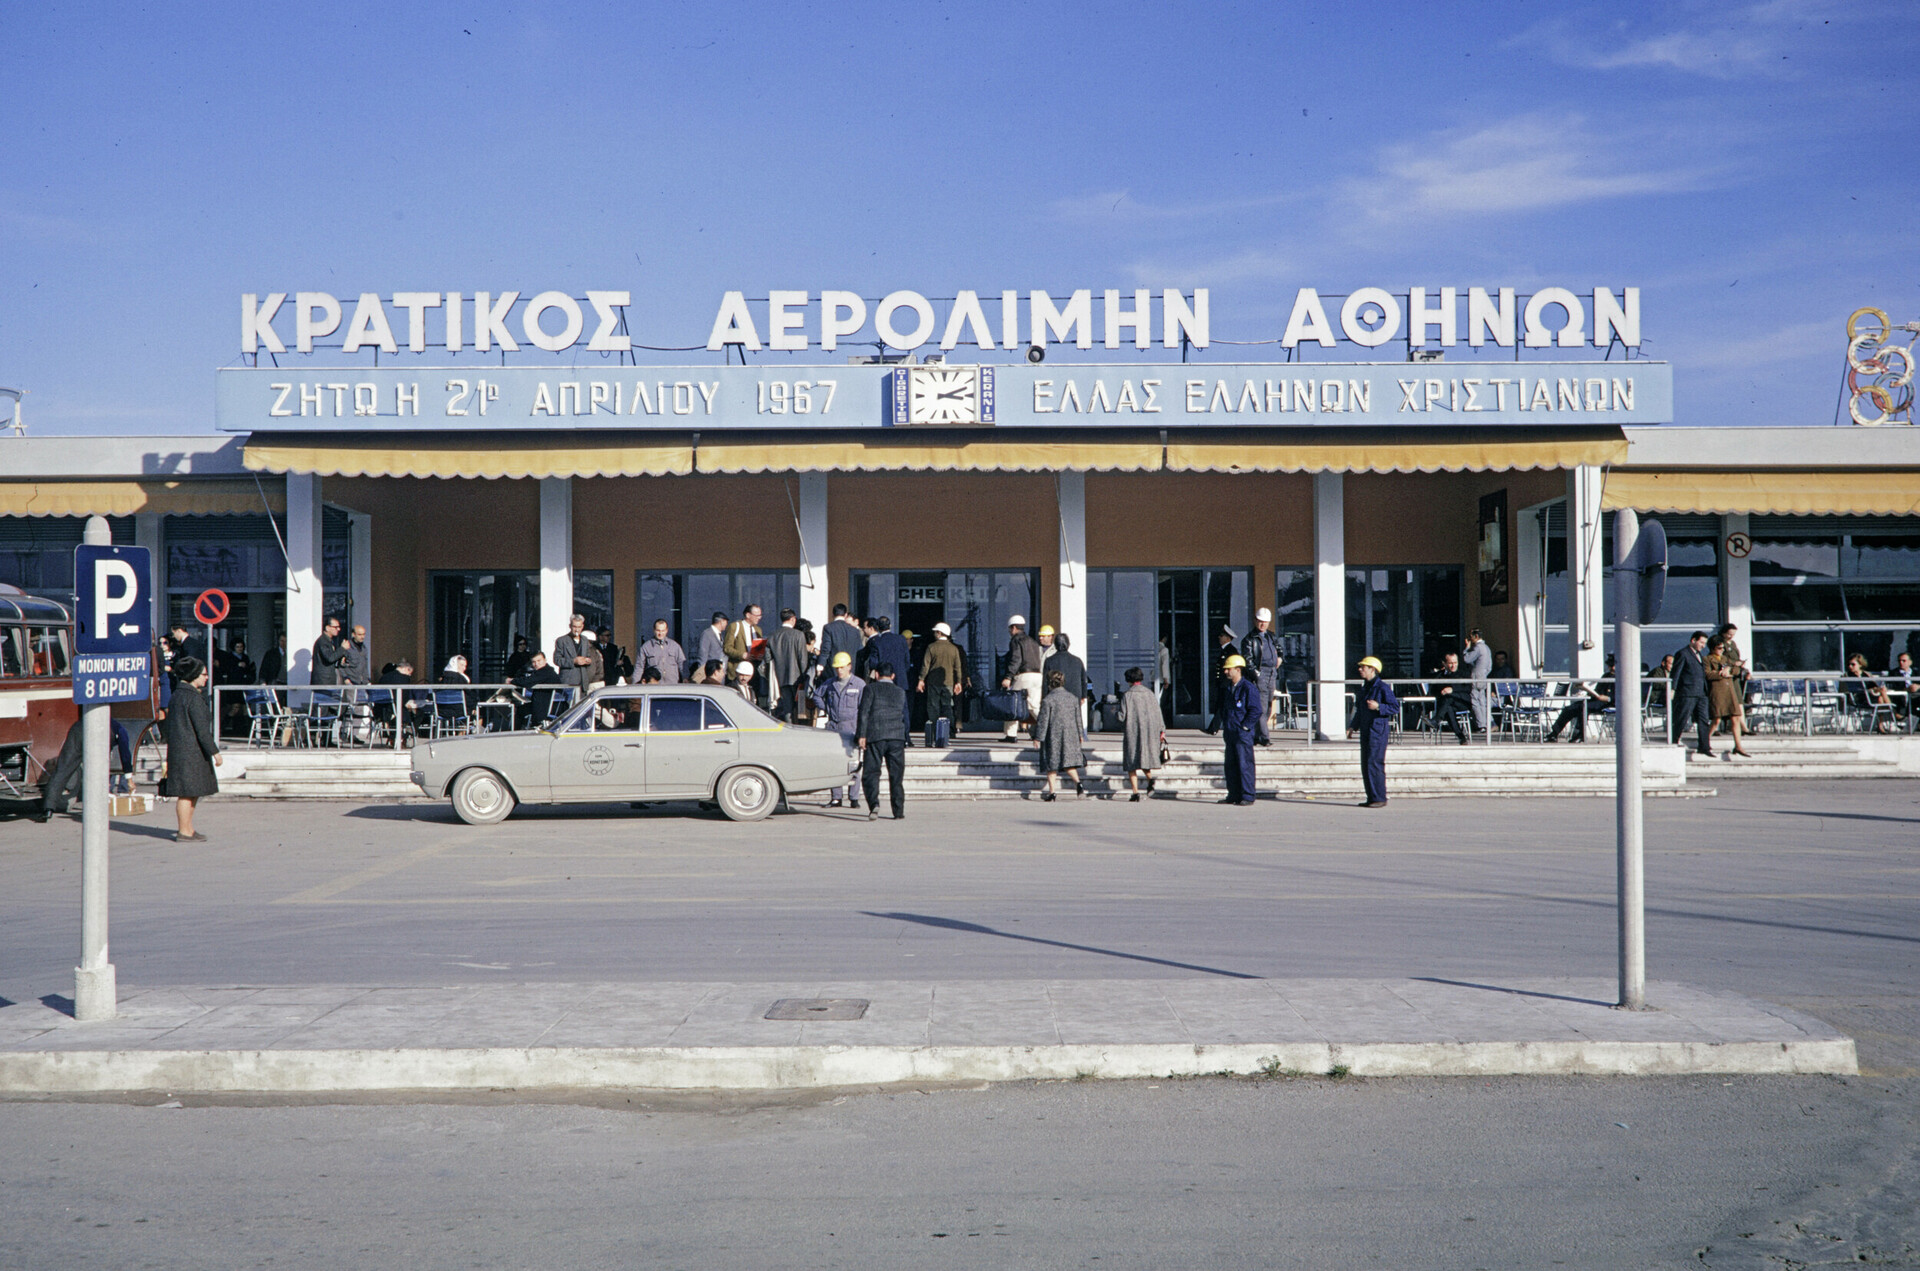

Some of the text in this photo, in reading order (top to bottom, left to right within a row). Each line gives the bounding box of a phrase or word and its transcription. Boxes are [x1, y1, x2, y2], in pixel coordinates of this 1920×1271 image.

[242, 286, 1640, 353] ΚΡΑΤΙΚΟΣ ΑΕΡΟΛΙΜΗΝ ΑΘΗΝΩΝ
[270, 383, 378, 417] ΖΗΤΩ
[397, 383, 419, 416] Η
[530, 381, 719, 416] ΑΠΡΙΛΙΟΥ
[758, 380, 837, 415] 1967
[896, 369, 907, 422] CIGARETTES
[982, 368, 993, 421] KERANIS
[1033, 377, 1634, 413] ΕΛΛΑΣ ΕΛΛΗΝΩΝ ΧΡΙΣΤΙΑΝΩΝ
[95, 559, 138, 639] P
[78, 656, 146, 674] ΜΟΝΟΝ ΜΕΧΡΙ
[85, 676, 137, 698] 8 ΩΡΩΝ
